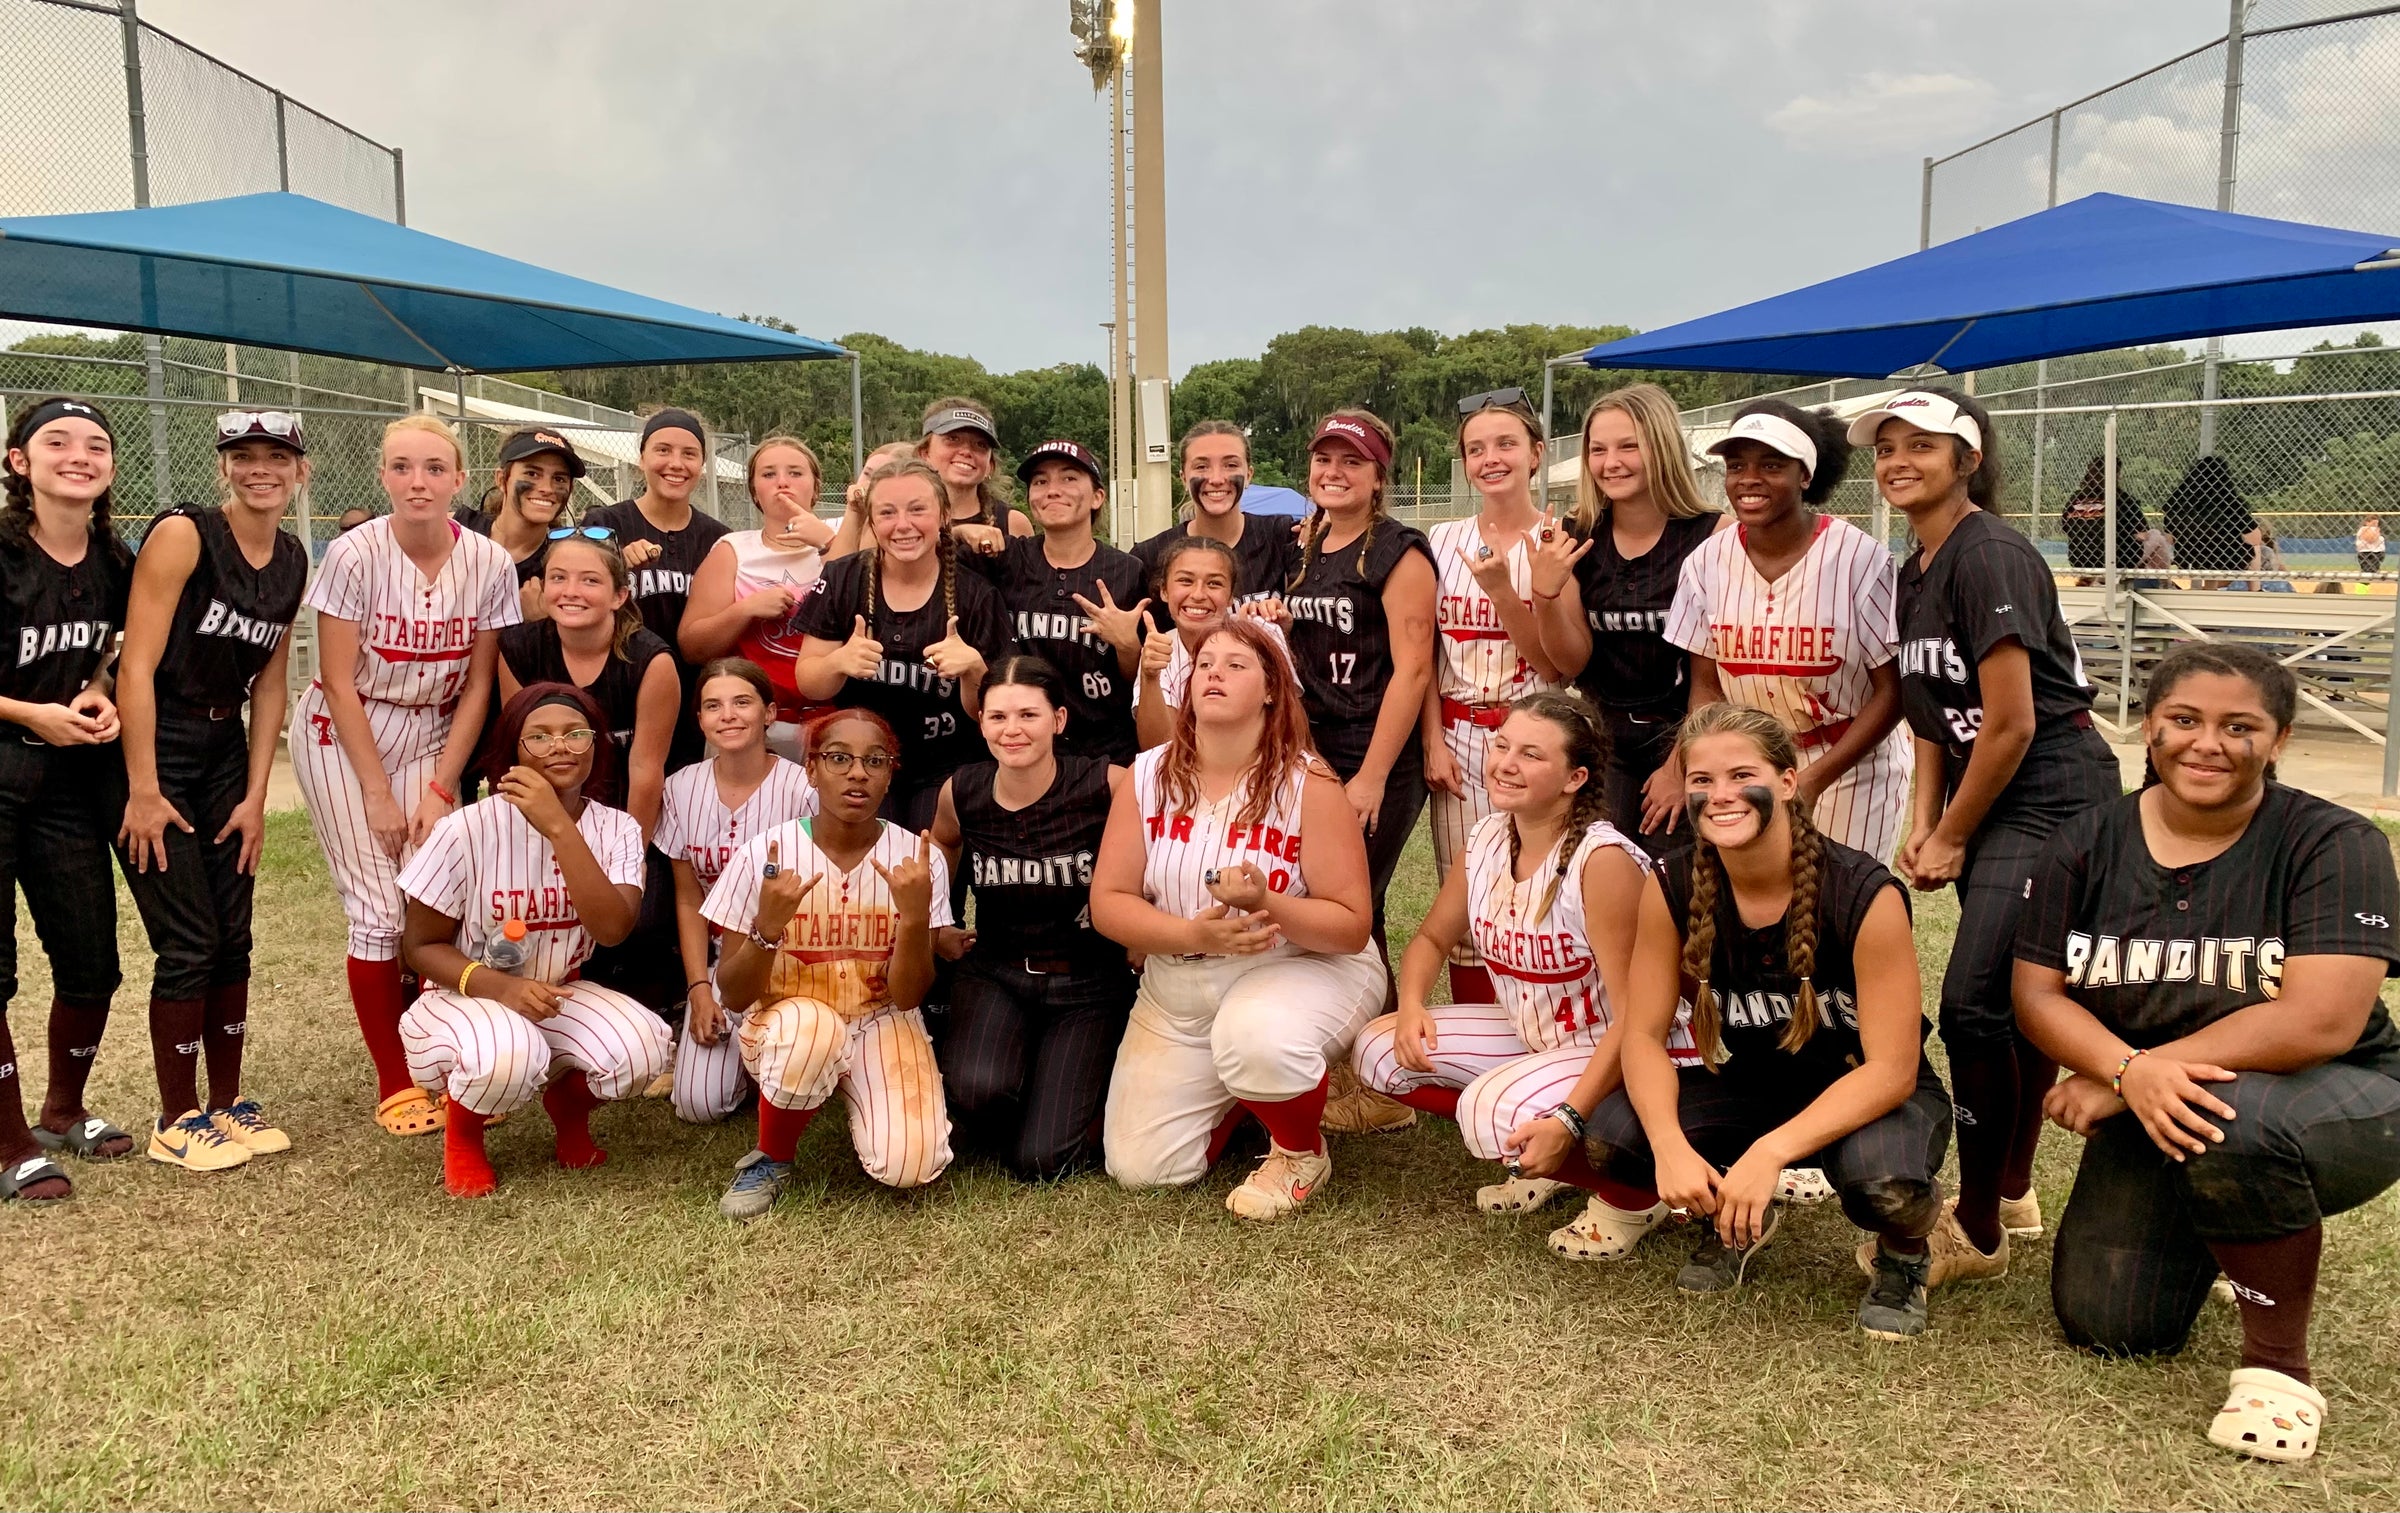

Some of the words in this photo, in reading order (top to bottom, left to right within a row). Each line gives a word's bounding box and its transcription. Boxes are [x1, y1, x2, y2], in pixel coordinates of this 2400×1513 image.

[628, 569, 694, 601] BANDI
[1082, 669, 1112, 700] 86
[1329, 652, 1357, 684] 17
[923, 711, 956, 740] 33
[972, 849, 1094, 888] BANDITS
[2065, 930, 2285, 1002] BANDITS
[1554, 985, 1600, 1032] 41
[1711, 986, 1860, 1031] ANDTS
